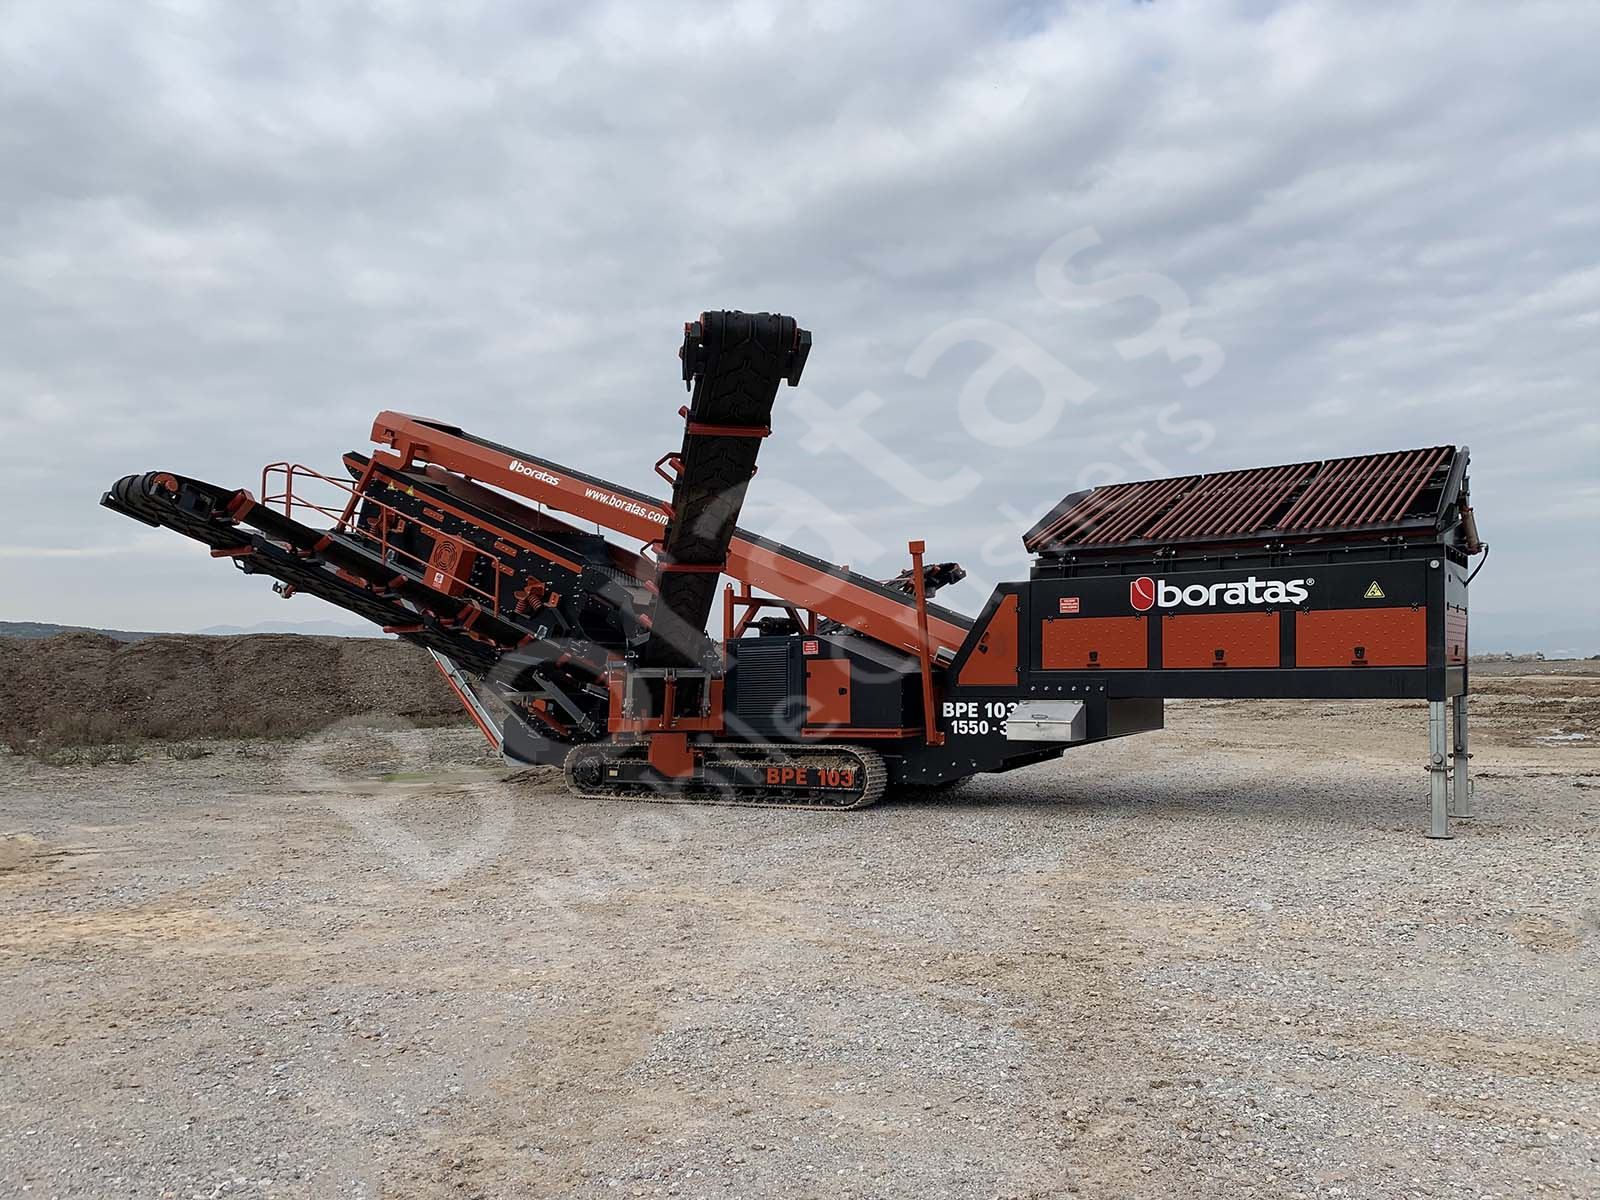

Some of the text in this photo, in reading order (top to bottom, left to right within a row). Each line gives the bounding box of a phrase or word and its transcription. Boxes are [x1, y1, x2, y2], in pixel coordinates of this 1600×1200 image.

[584, 487, 669, 526] www.boratas.com
[943, 702, 979, 718] BPE
[951, 720, 989, 735] 1550
[766, 767, 854, 787] BPE 103
